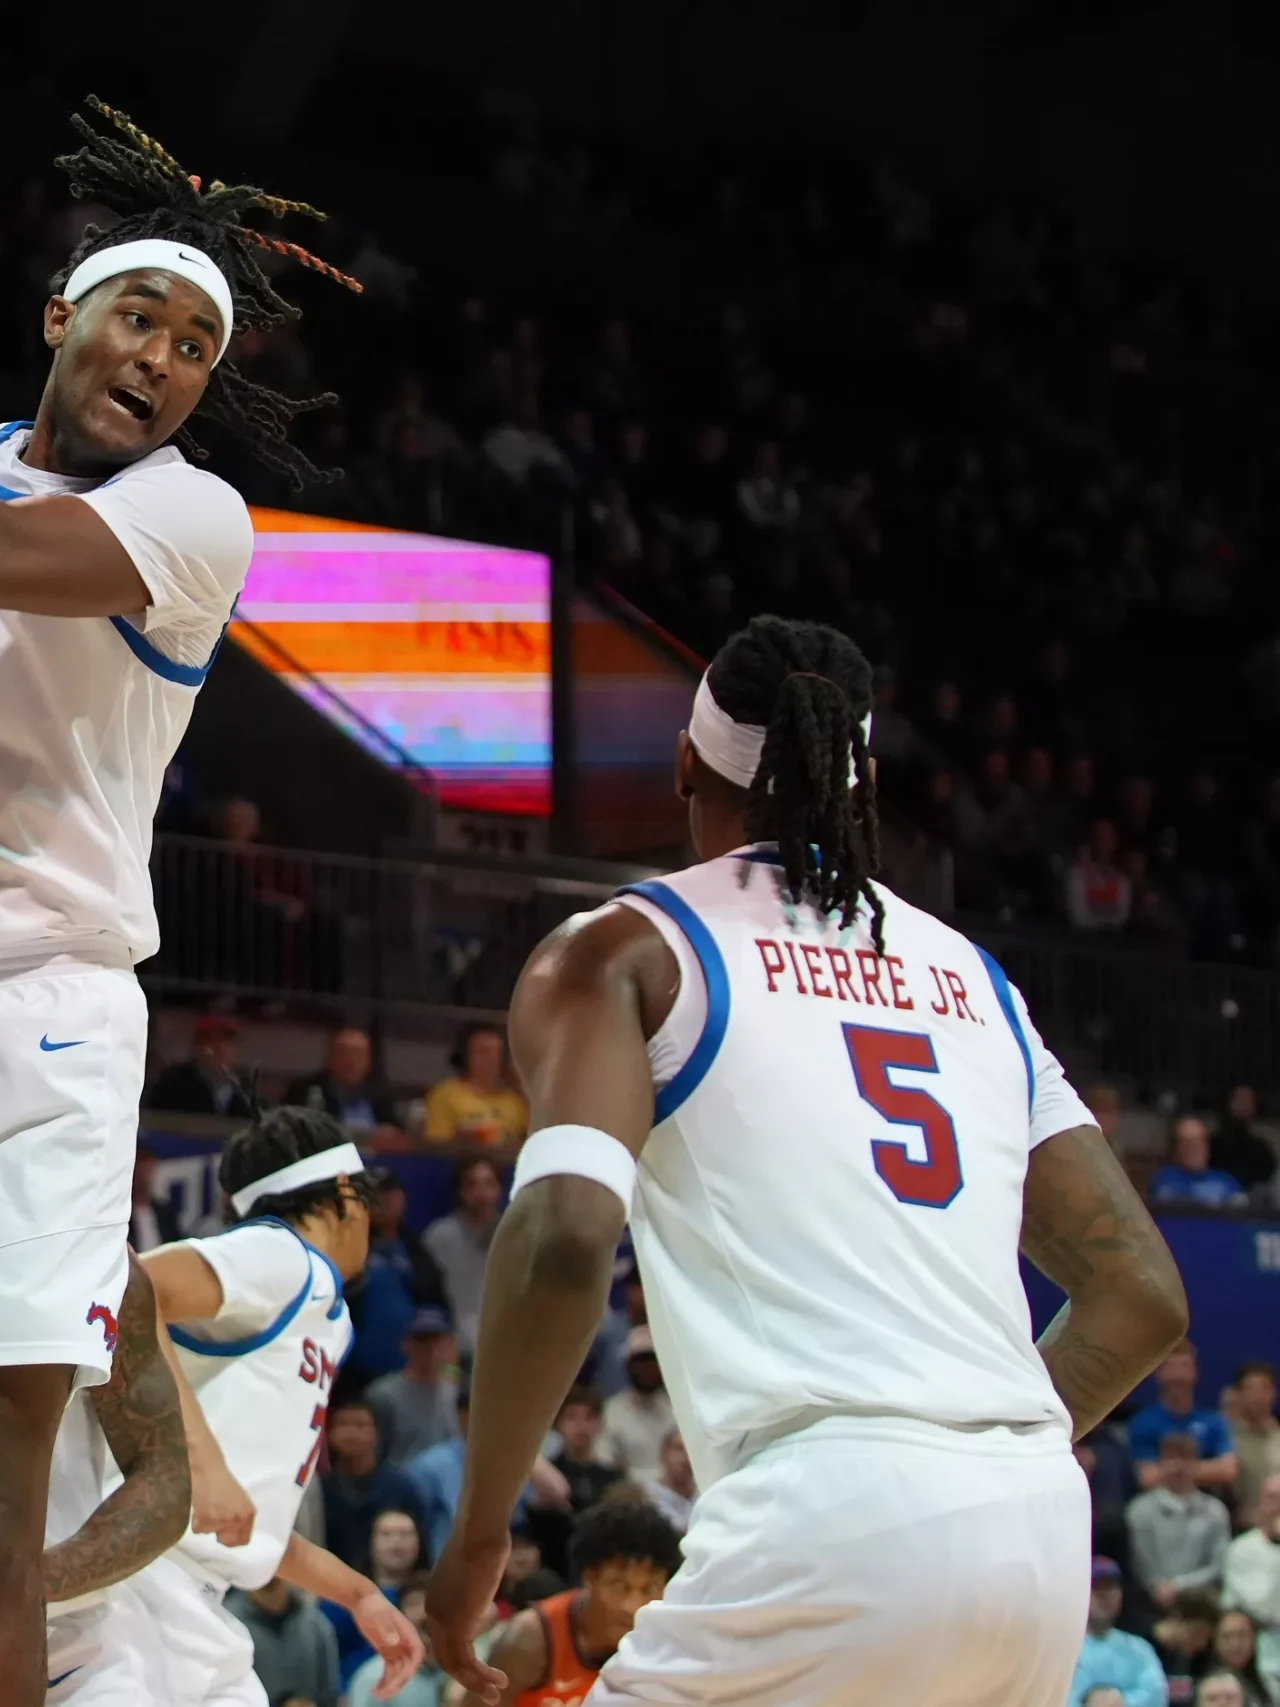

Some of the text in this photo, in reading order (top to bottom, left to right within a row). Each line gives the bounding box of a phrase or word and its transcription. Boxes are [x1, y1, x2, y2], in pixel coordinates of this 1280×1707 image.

[753, 937, 986, 1026] PIERRE JR.
[840, 1021, 965, 1210] 5
